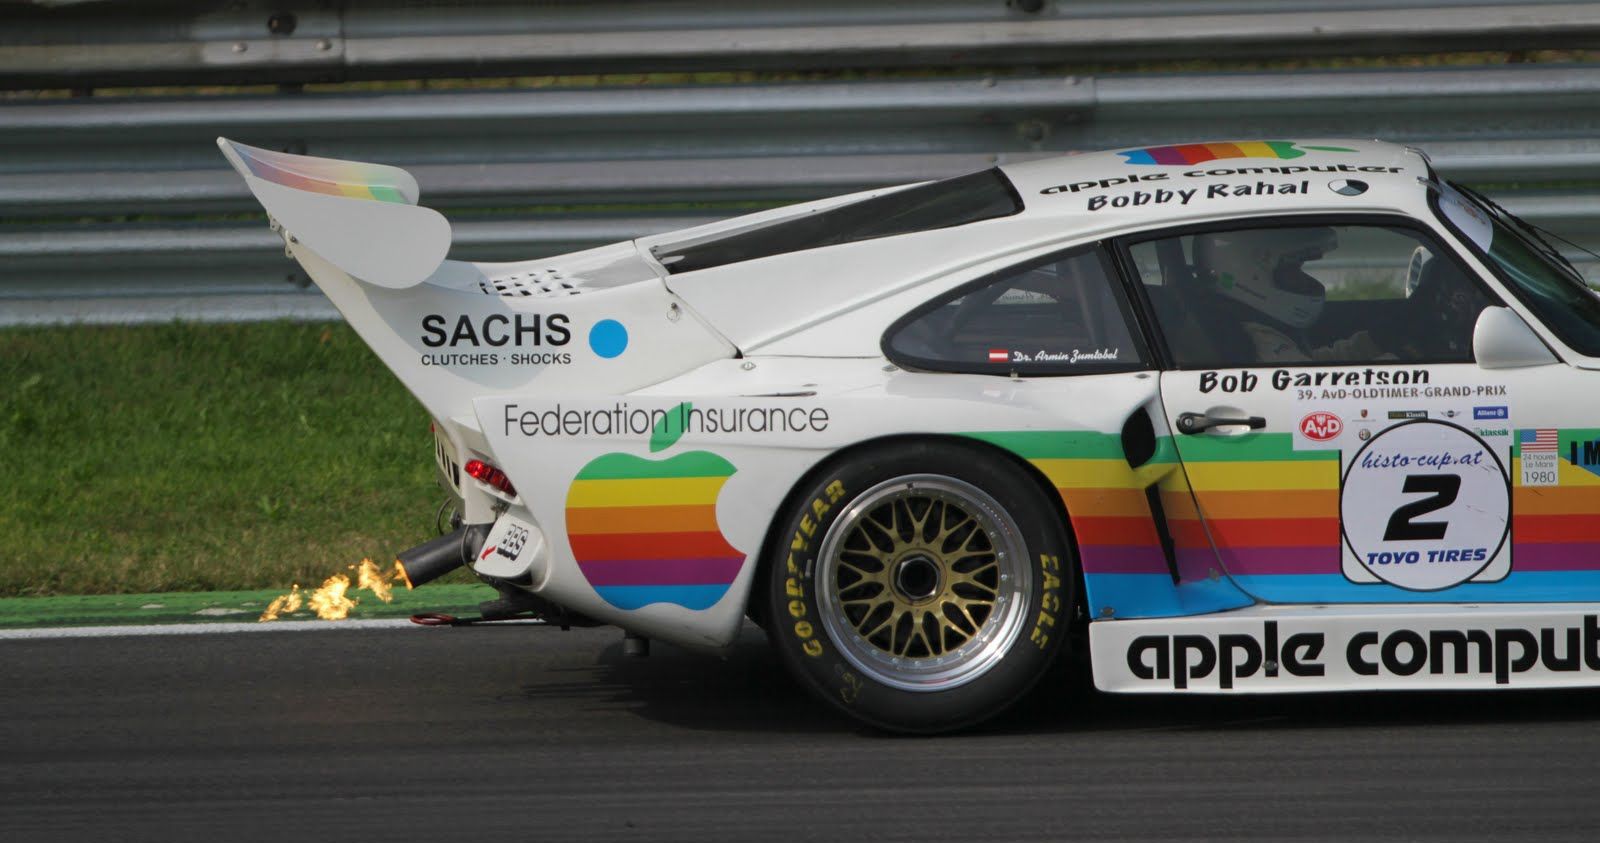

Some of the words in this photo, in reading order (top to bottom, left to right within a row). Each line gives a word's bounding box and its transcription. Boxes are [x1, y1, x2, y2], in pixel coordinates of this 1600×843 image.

[1040, 171, 1170, 195] apple
[1183, 164, 1404, 178] computer
[1087, 188, 1198, 211] Bobby
[1207, 180, 1309, 199] Rahal
[421, 313, 571, 347] SACHS
[421, 353, 498, 365] CLUTCHES
[511, 352, 571, 365] SHOCKS
[1013, 351, 1032, 362] Dr.
[1035, 350, 1069, 361] Armin
[1070, 348, 1118, 363] Zumtobel
[1199, 370, 1258, 393] Bob
[1272, 369, 1430, 391] Garretson
[1297, 389, 1317, 400] 39.
[1321, 385, 1506, 399] AvD-OLDTIMER-GRAND-PRIX
[505, 402, 667, 436] Federation
[680, 401, 829, 433] Insurance
[1361, 450, 1483, 470] histo-cup.at
[1525, 471, 1555, 483] 1980
[1383, 473, 1462, 542] 2
[497, 523, 529, 561] BBS
[1367, 551, 1420, 565] TOYO
[1427, 548, 1487, 563] TIRES
[1031, 553, 1061, 649] EAGLE
[1126, 620, 1325, 689] apple
